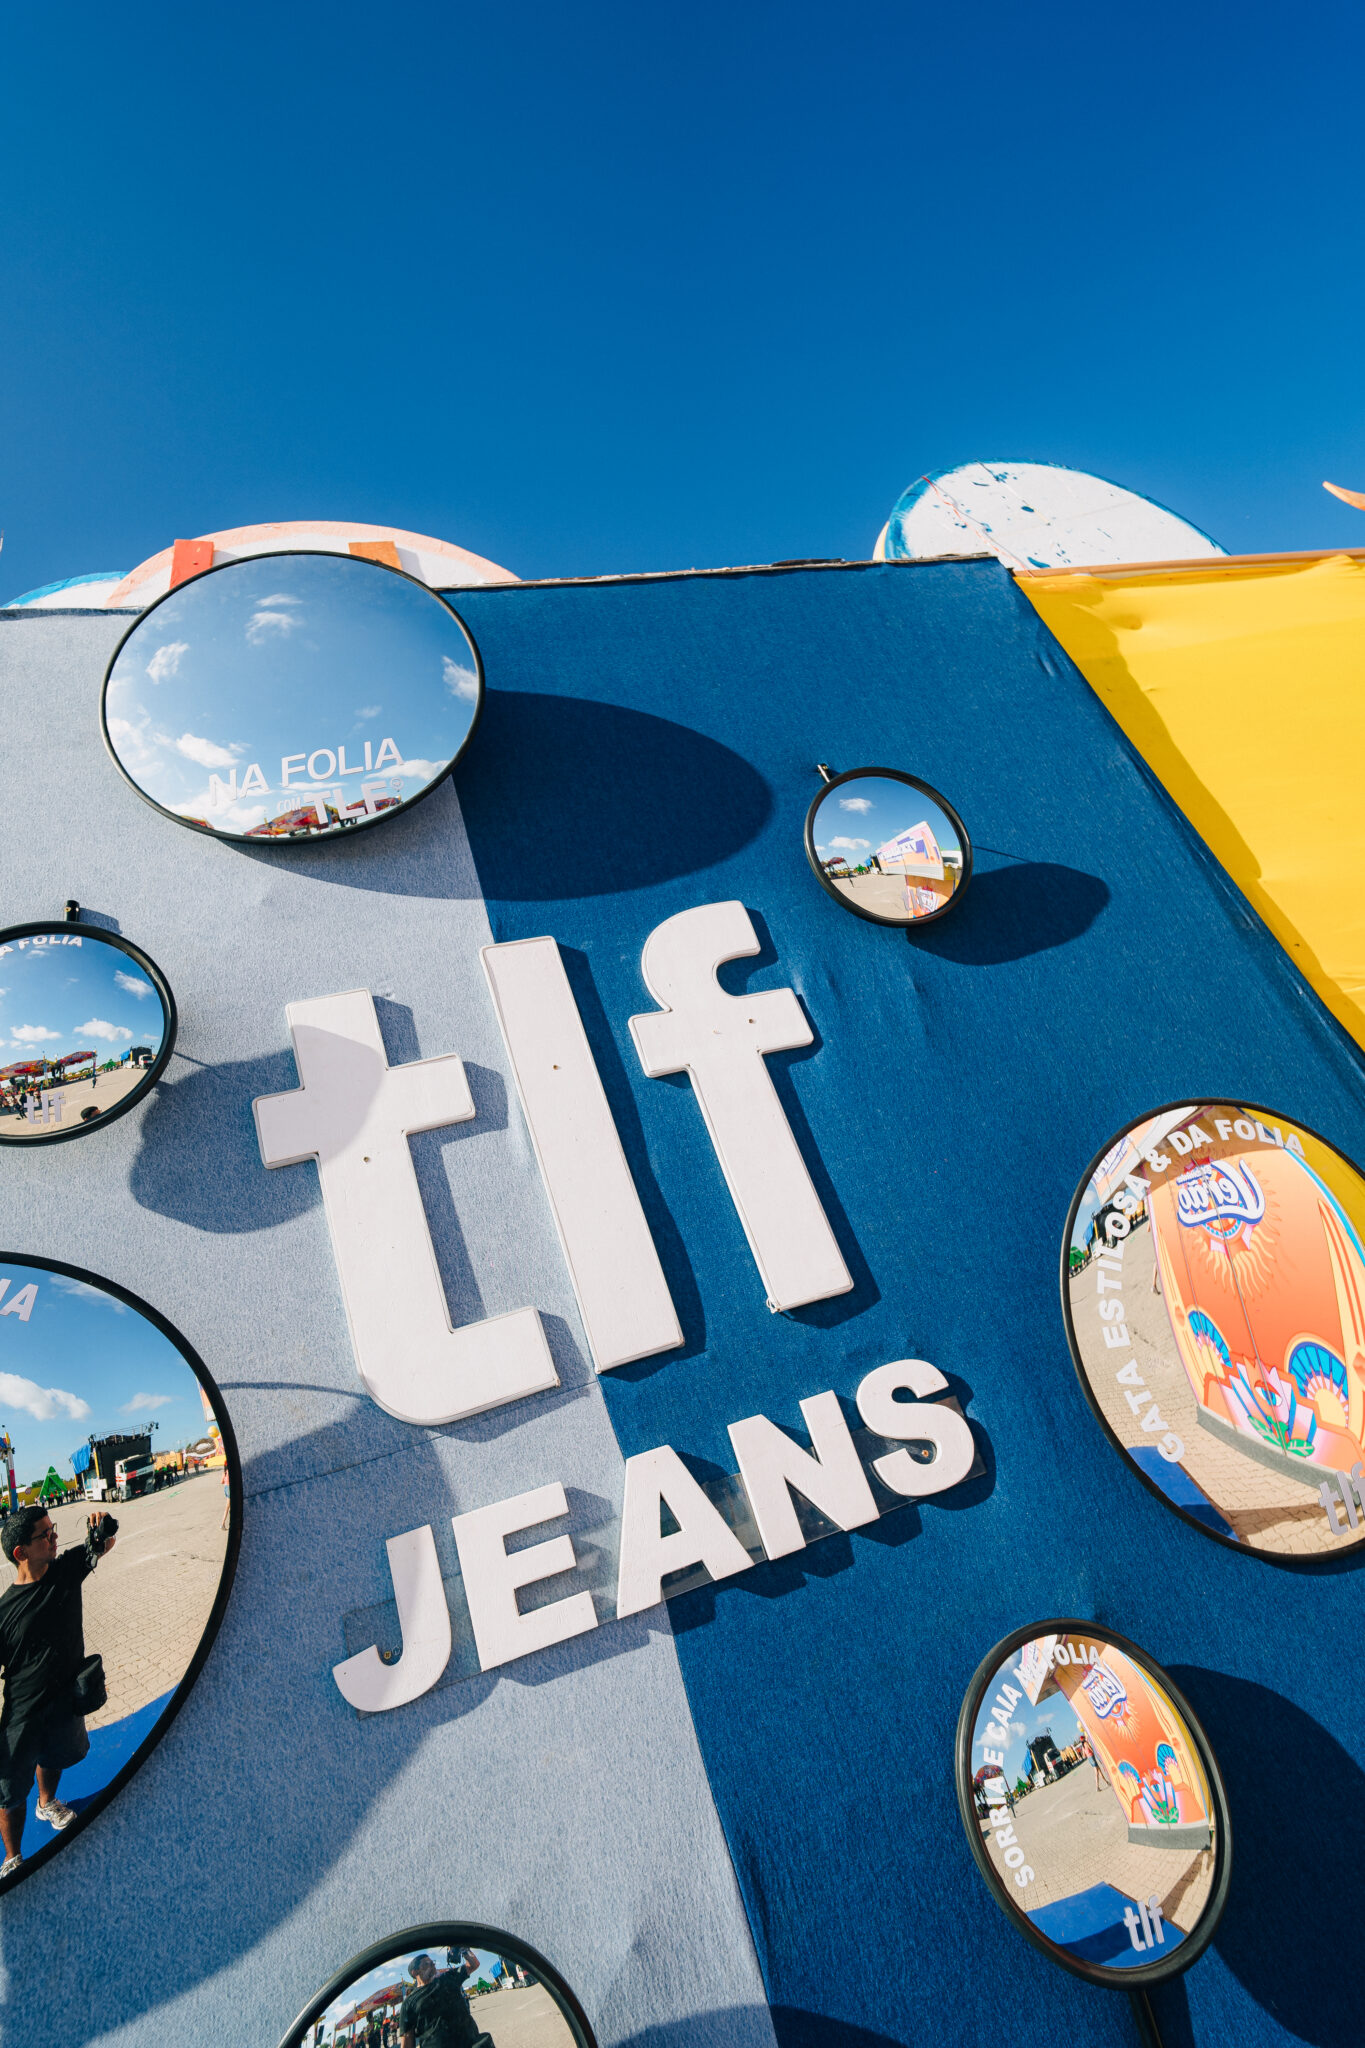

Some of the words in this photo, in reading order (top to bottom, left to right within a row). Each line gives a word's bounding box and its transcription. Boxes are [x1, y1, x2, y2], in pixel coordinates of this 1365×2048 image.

[208, 763, 270, 806] NA
[281, 737, 404, 787] FOLIA
[277, 799, 301, 814] COM
[19, 934, 83, 950] FOLIA
[24, 1092, 66, 1125] tlf
[1145, 1147, 1172, 1172] &
[1167, 1122, 1214, 1156] DA
[1216, 1119, 1306, 1157] FOLIA
[252, 900, 854, 1426] tlf
[1096, 1172, 1152, 1350] ESTILOSA
[1116, 1360, 1185, 1463] GATA
[332, 1359, 976, 1712] JEANS
[1042, 1643, 1101, 1669] FOLIA
[990, 1683, 1024, 1740] CAIA
[983, 1747, 1004, 1768] E
[986, 1774, 1035, 1888] SORRIA
[1123, 1895, 1165, 1951] tlf
